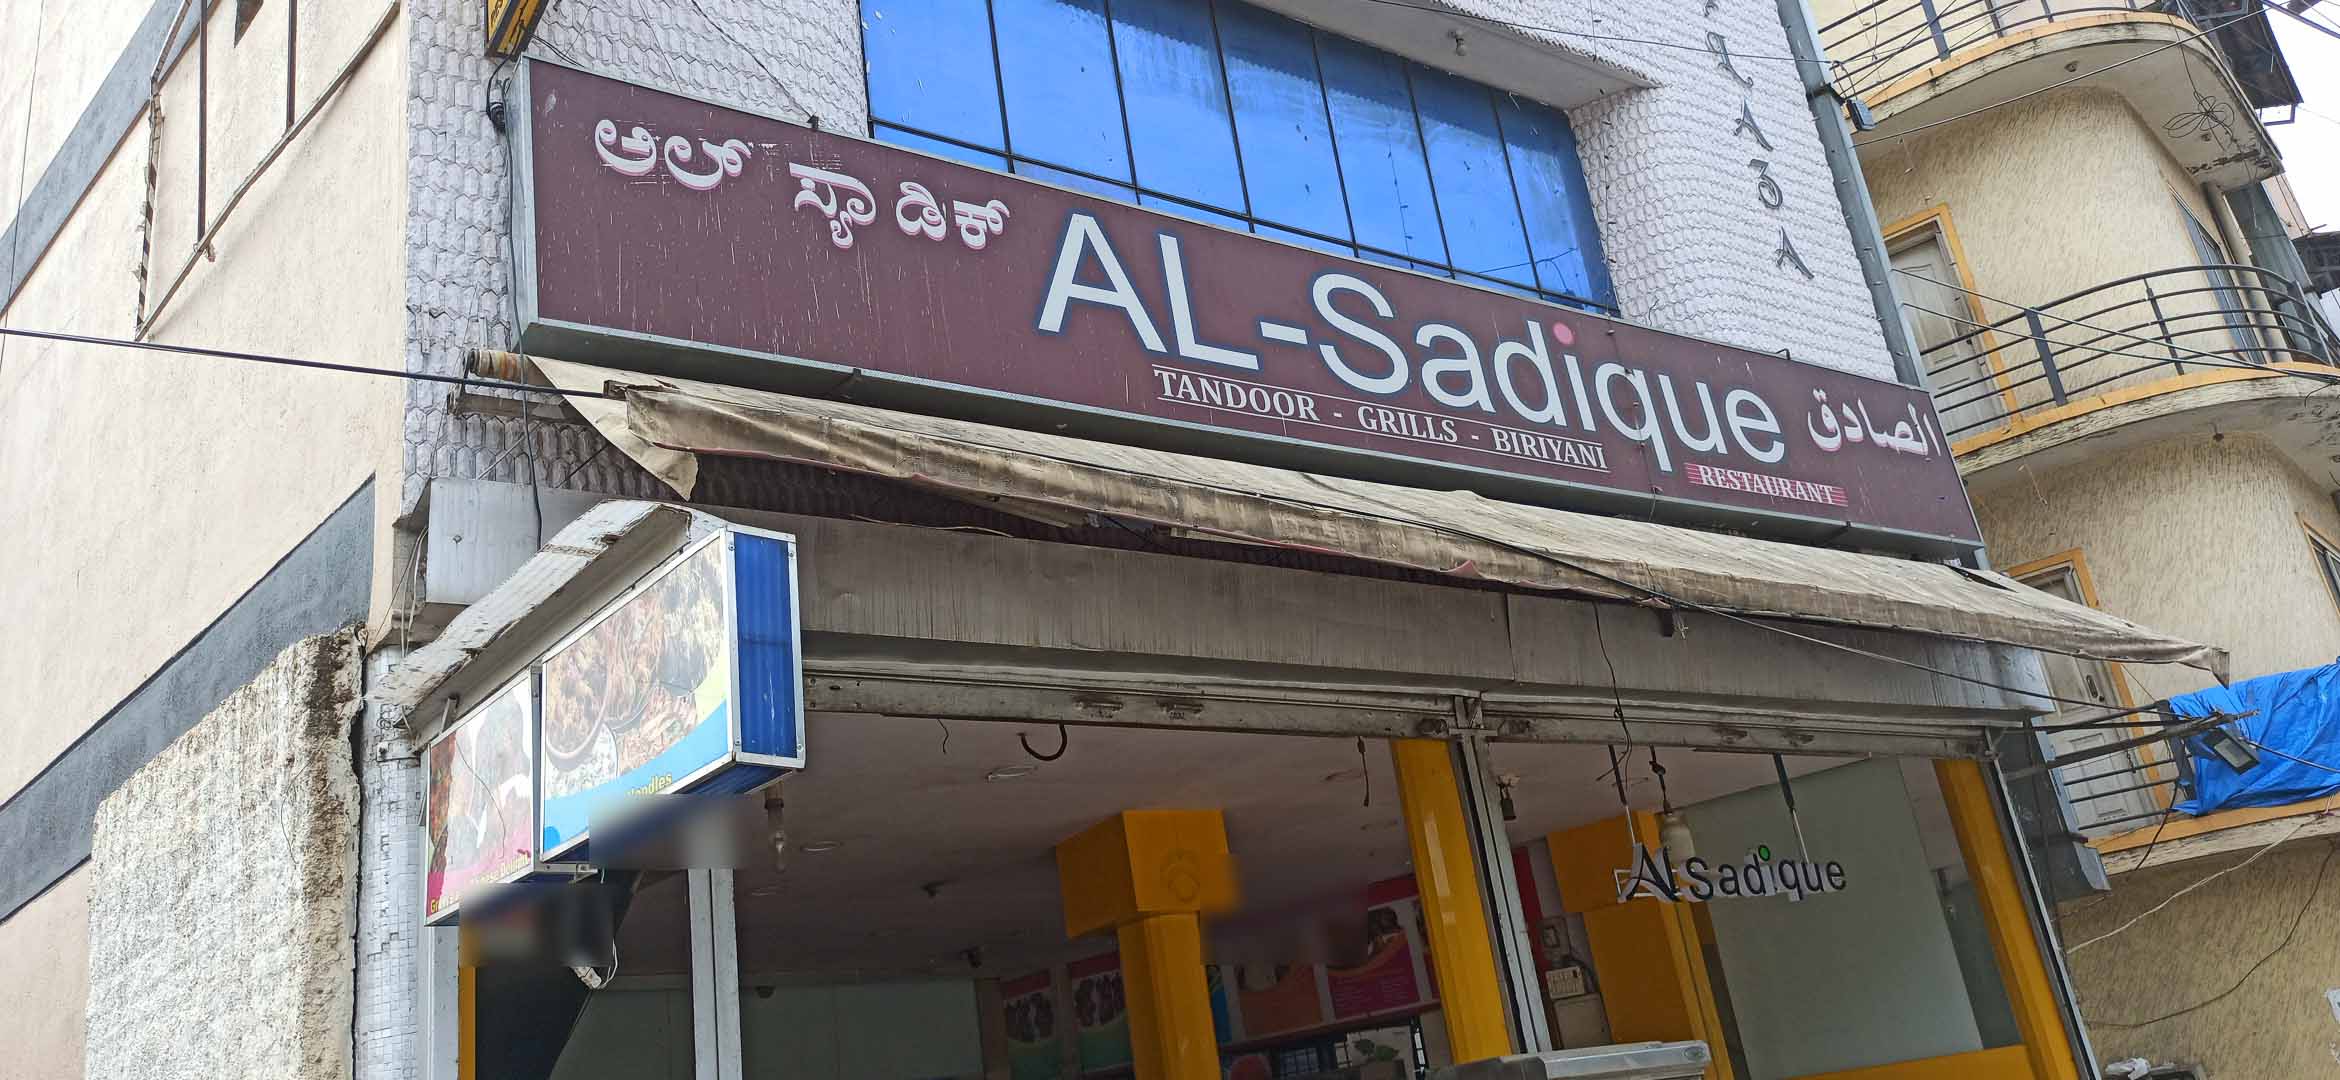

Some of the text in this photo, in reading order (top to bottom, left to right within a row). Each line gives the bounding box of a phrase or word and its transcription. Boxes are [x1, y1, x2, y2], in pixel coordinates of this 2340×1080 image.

[1038, 213, 1786, 472] AL-Sadique
[1153, 369, 1320, 422] TANDOOR
[1357, 406, 1458, 443] GRILLS
[1491, 428, 1608, 470] BIRIYANI
[1807, 388, 1941, 457] الصادق
[1697, 465, 1834, 505] RESTAURANT
